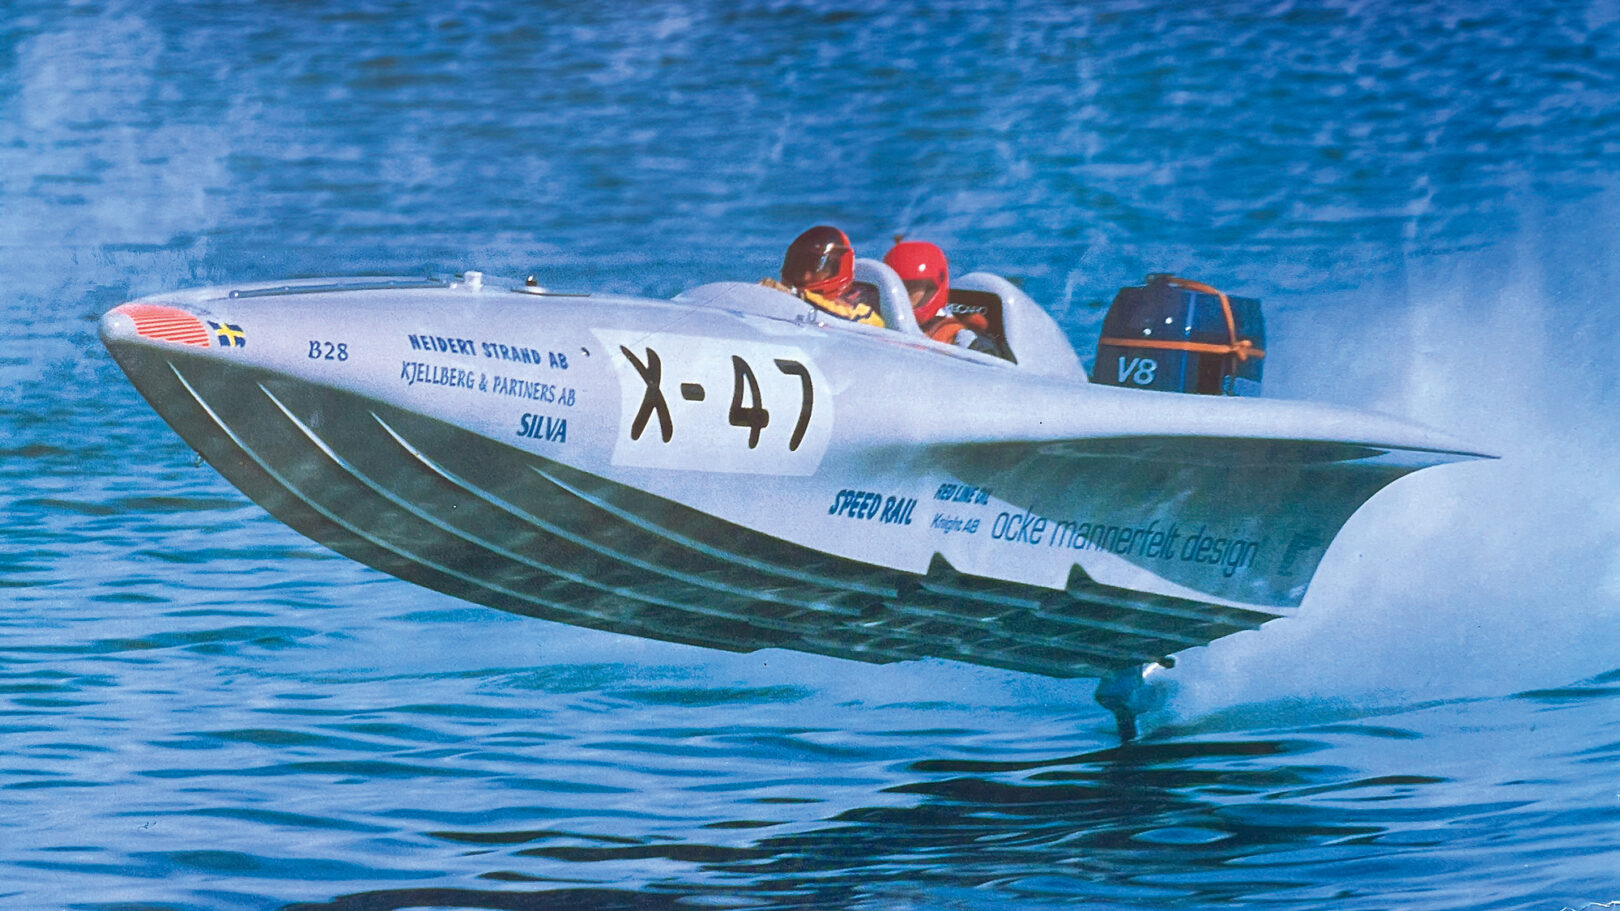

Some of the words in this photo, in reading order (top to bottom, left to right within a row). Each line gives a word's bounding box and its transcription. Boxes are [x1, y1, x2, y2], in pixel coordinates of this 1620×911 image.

[308, 340, 348, 362] B28
[408, 335, 476, 356] NEIDERT
[482, 342, 541, 364] STRAND
[549, 351, 569, 370] AB
[401, 361, 475, 389] KJELLBERG
[479, 373, 488, 393] &
[493, 376, 556, 403] PARTNERS
[558, 387, 576, 407] AB
[1117, 355, 1156, 384] V8
[517, 413, 567, 443] SILVA
[828, 489, 881, 520] SPEED
[880, 496, 918, 525] RAIL
[992, 505, 1047, 545] ocke
[1049, 519, 1179, 560] mannerfelt
[1180, 524, 1259, 578] design
